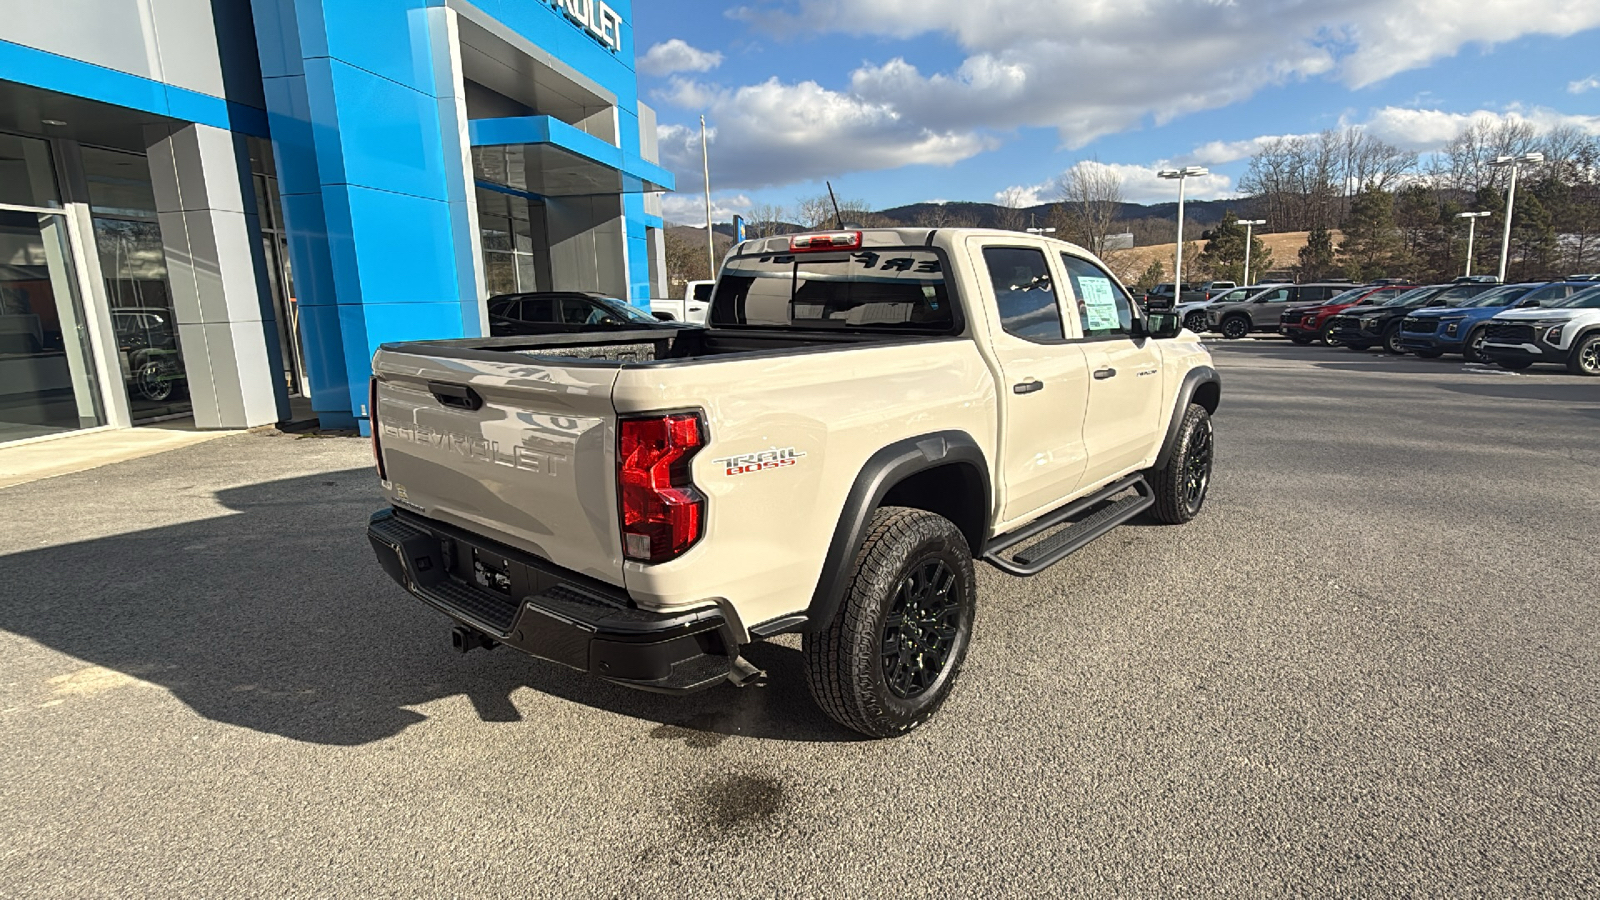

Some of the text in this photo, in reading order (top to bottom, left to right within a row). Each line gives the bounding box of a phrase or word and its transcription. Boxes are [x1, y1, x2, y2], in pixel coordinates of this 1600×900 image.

[382, 418, 567, 477] CHEVROLET
[712, 447, 807, 468] TRAIL
[726, 459, 796, 476] BOSS
